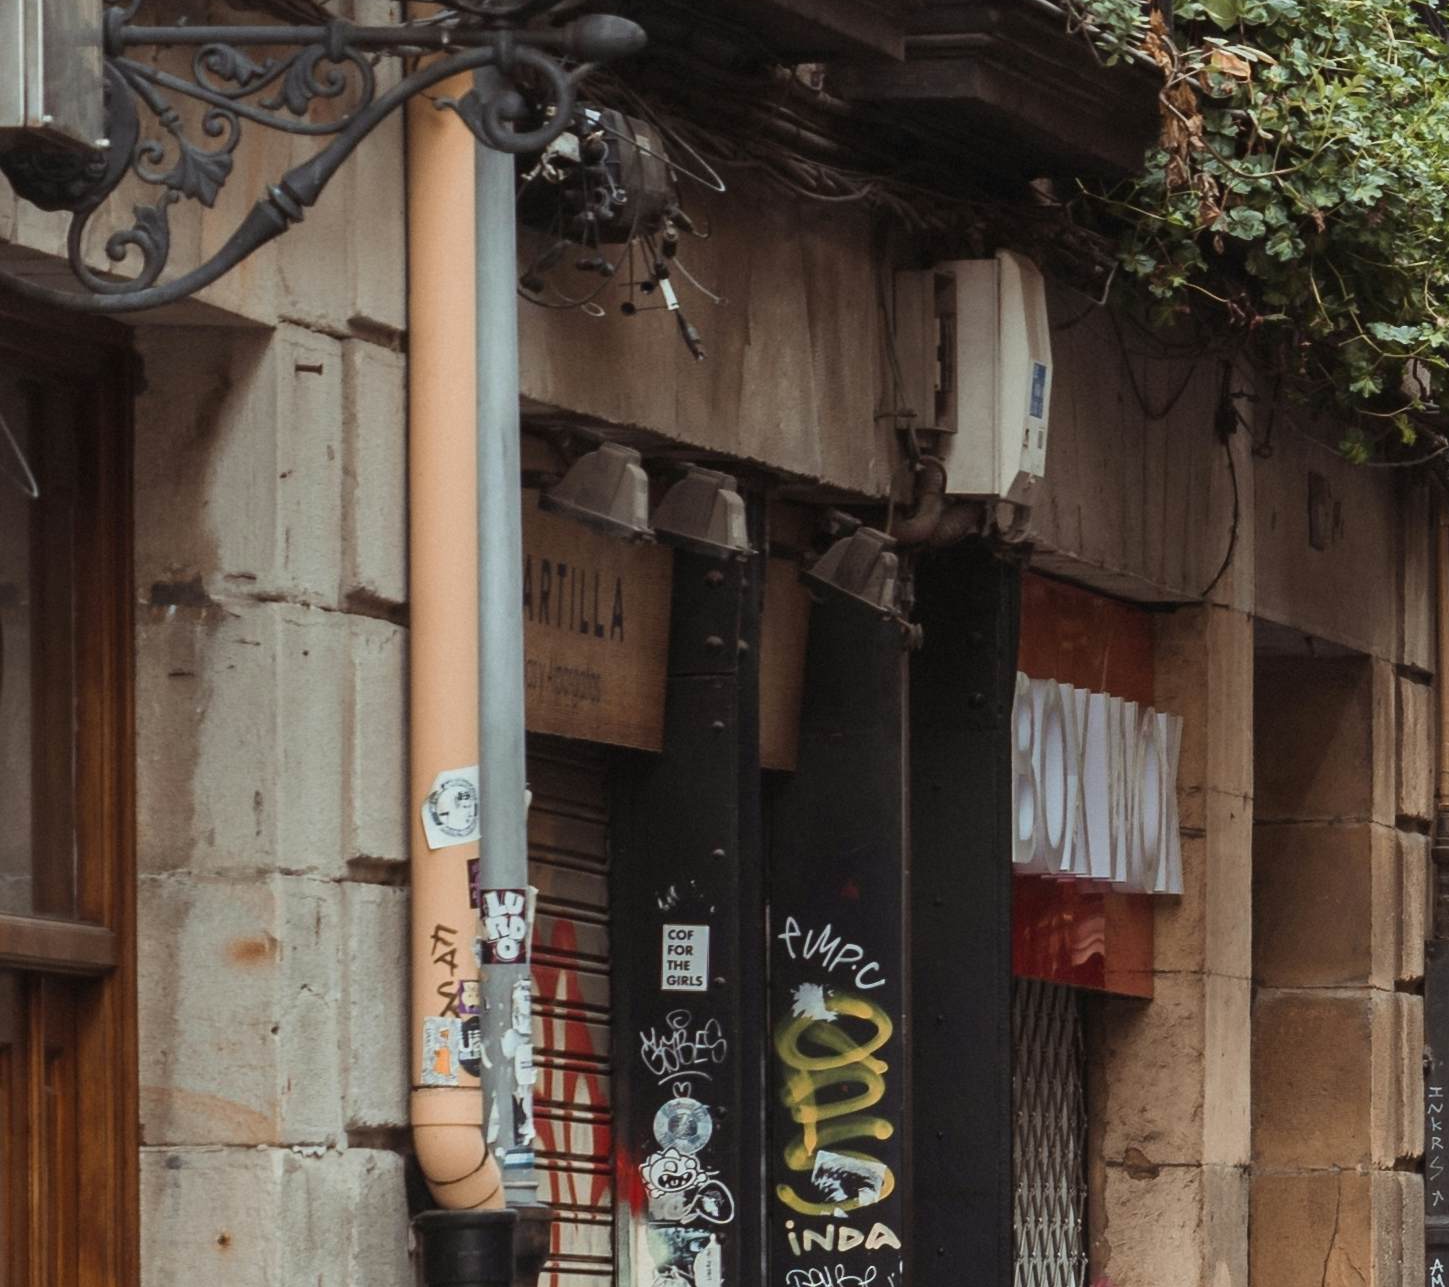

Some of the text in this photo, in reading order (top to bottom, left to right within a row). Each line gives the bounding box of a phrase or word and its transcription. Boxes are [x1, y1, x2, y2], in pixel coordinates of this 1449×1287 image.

[668, 930, 694, 941] COF
[667, 945, 693, 956] FOR
[667, 960, 690, 971] THE
[667, 975, 703, 987] GIRLS
